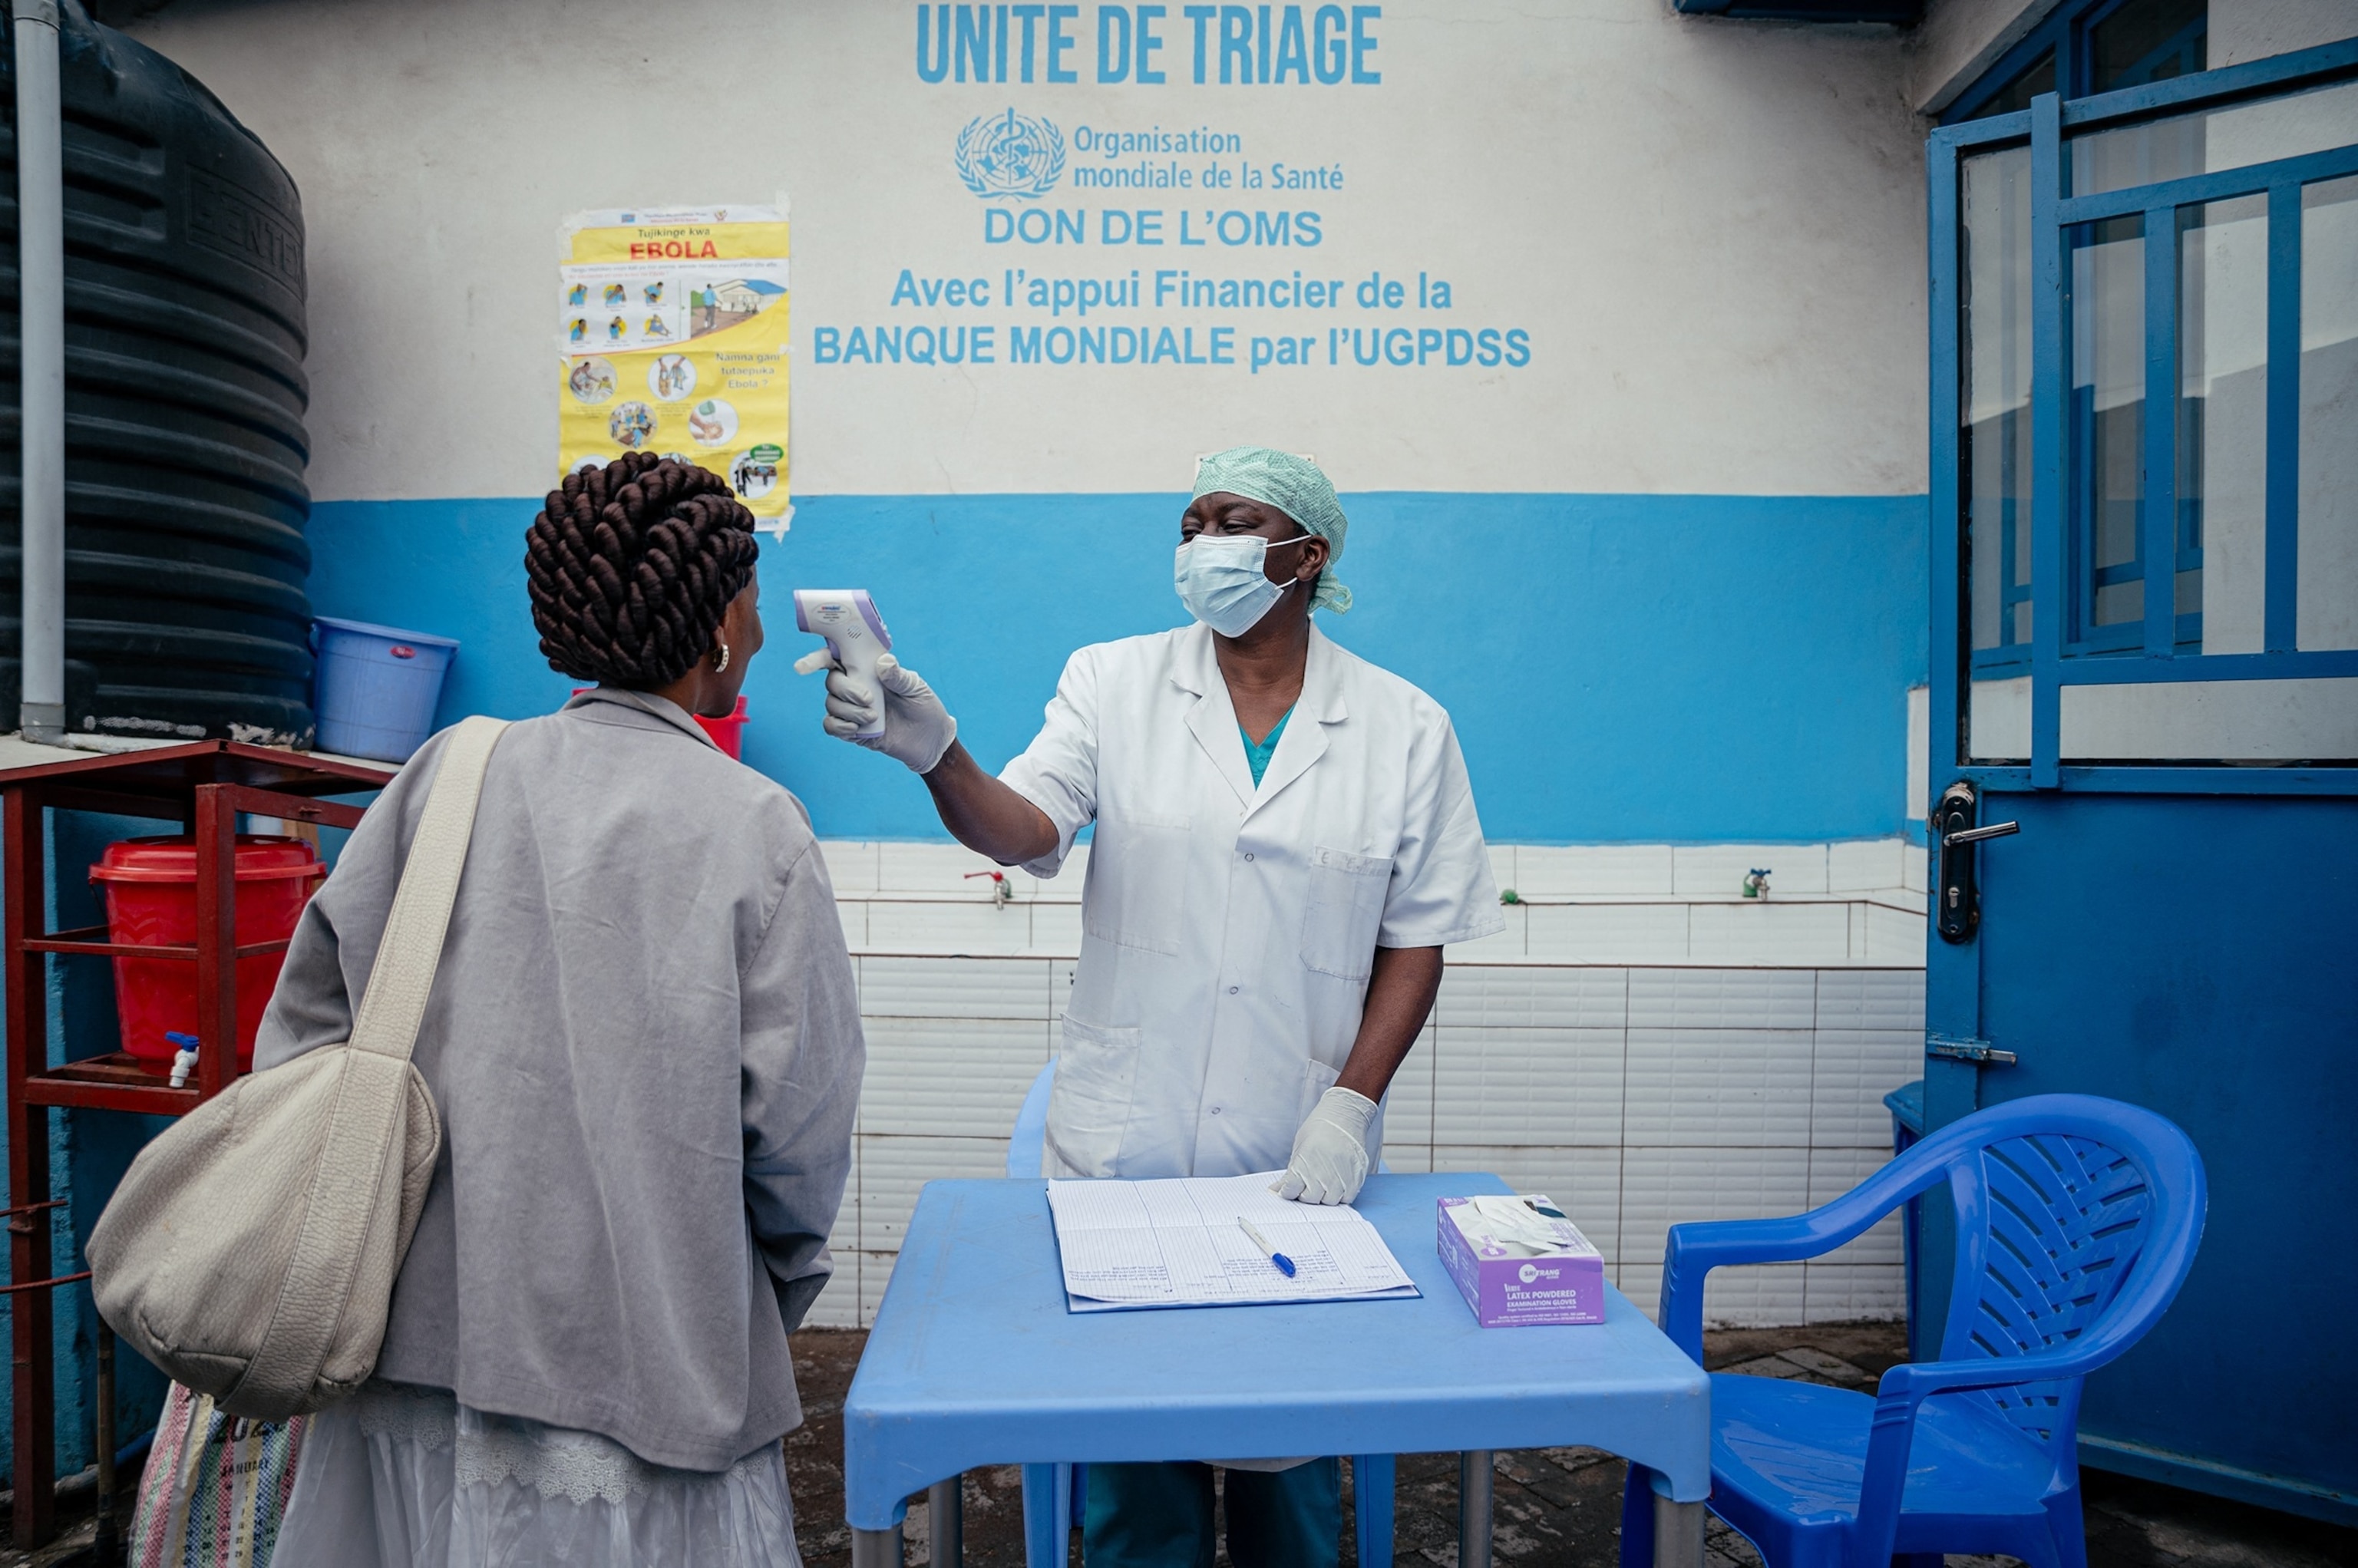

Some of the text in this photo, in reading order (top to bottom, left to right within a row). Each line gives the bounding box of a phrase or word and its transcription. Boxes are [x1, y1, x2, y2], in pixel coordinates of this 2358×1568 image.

[916, 4, 1382, 85] UNITE DE TRIAGE
[1075, 125, 1240, 158] Organisation
[1075, 161, 1343, 190] mondiale de la Santé
[639, 228, 710, 238] Tujikinge kwa
[985, 208, 1322, 246] DON DE L’OMS
[630, 240, 718, 259] EBOLA
[891, 269, 1451, 317] Avec l’appui Financier de la
[716, 352, 780, 363] Namna gani
[814, 326, 1531, 374] BANQUE MONDIALE par l’UGPDSS
[722, 367, 774, 375] tutaepuka
[1507, 1289, 1577, 1300] LATEX POWDERED
[1507, 1299, 1551, 1308] EXAMINATION
